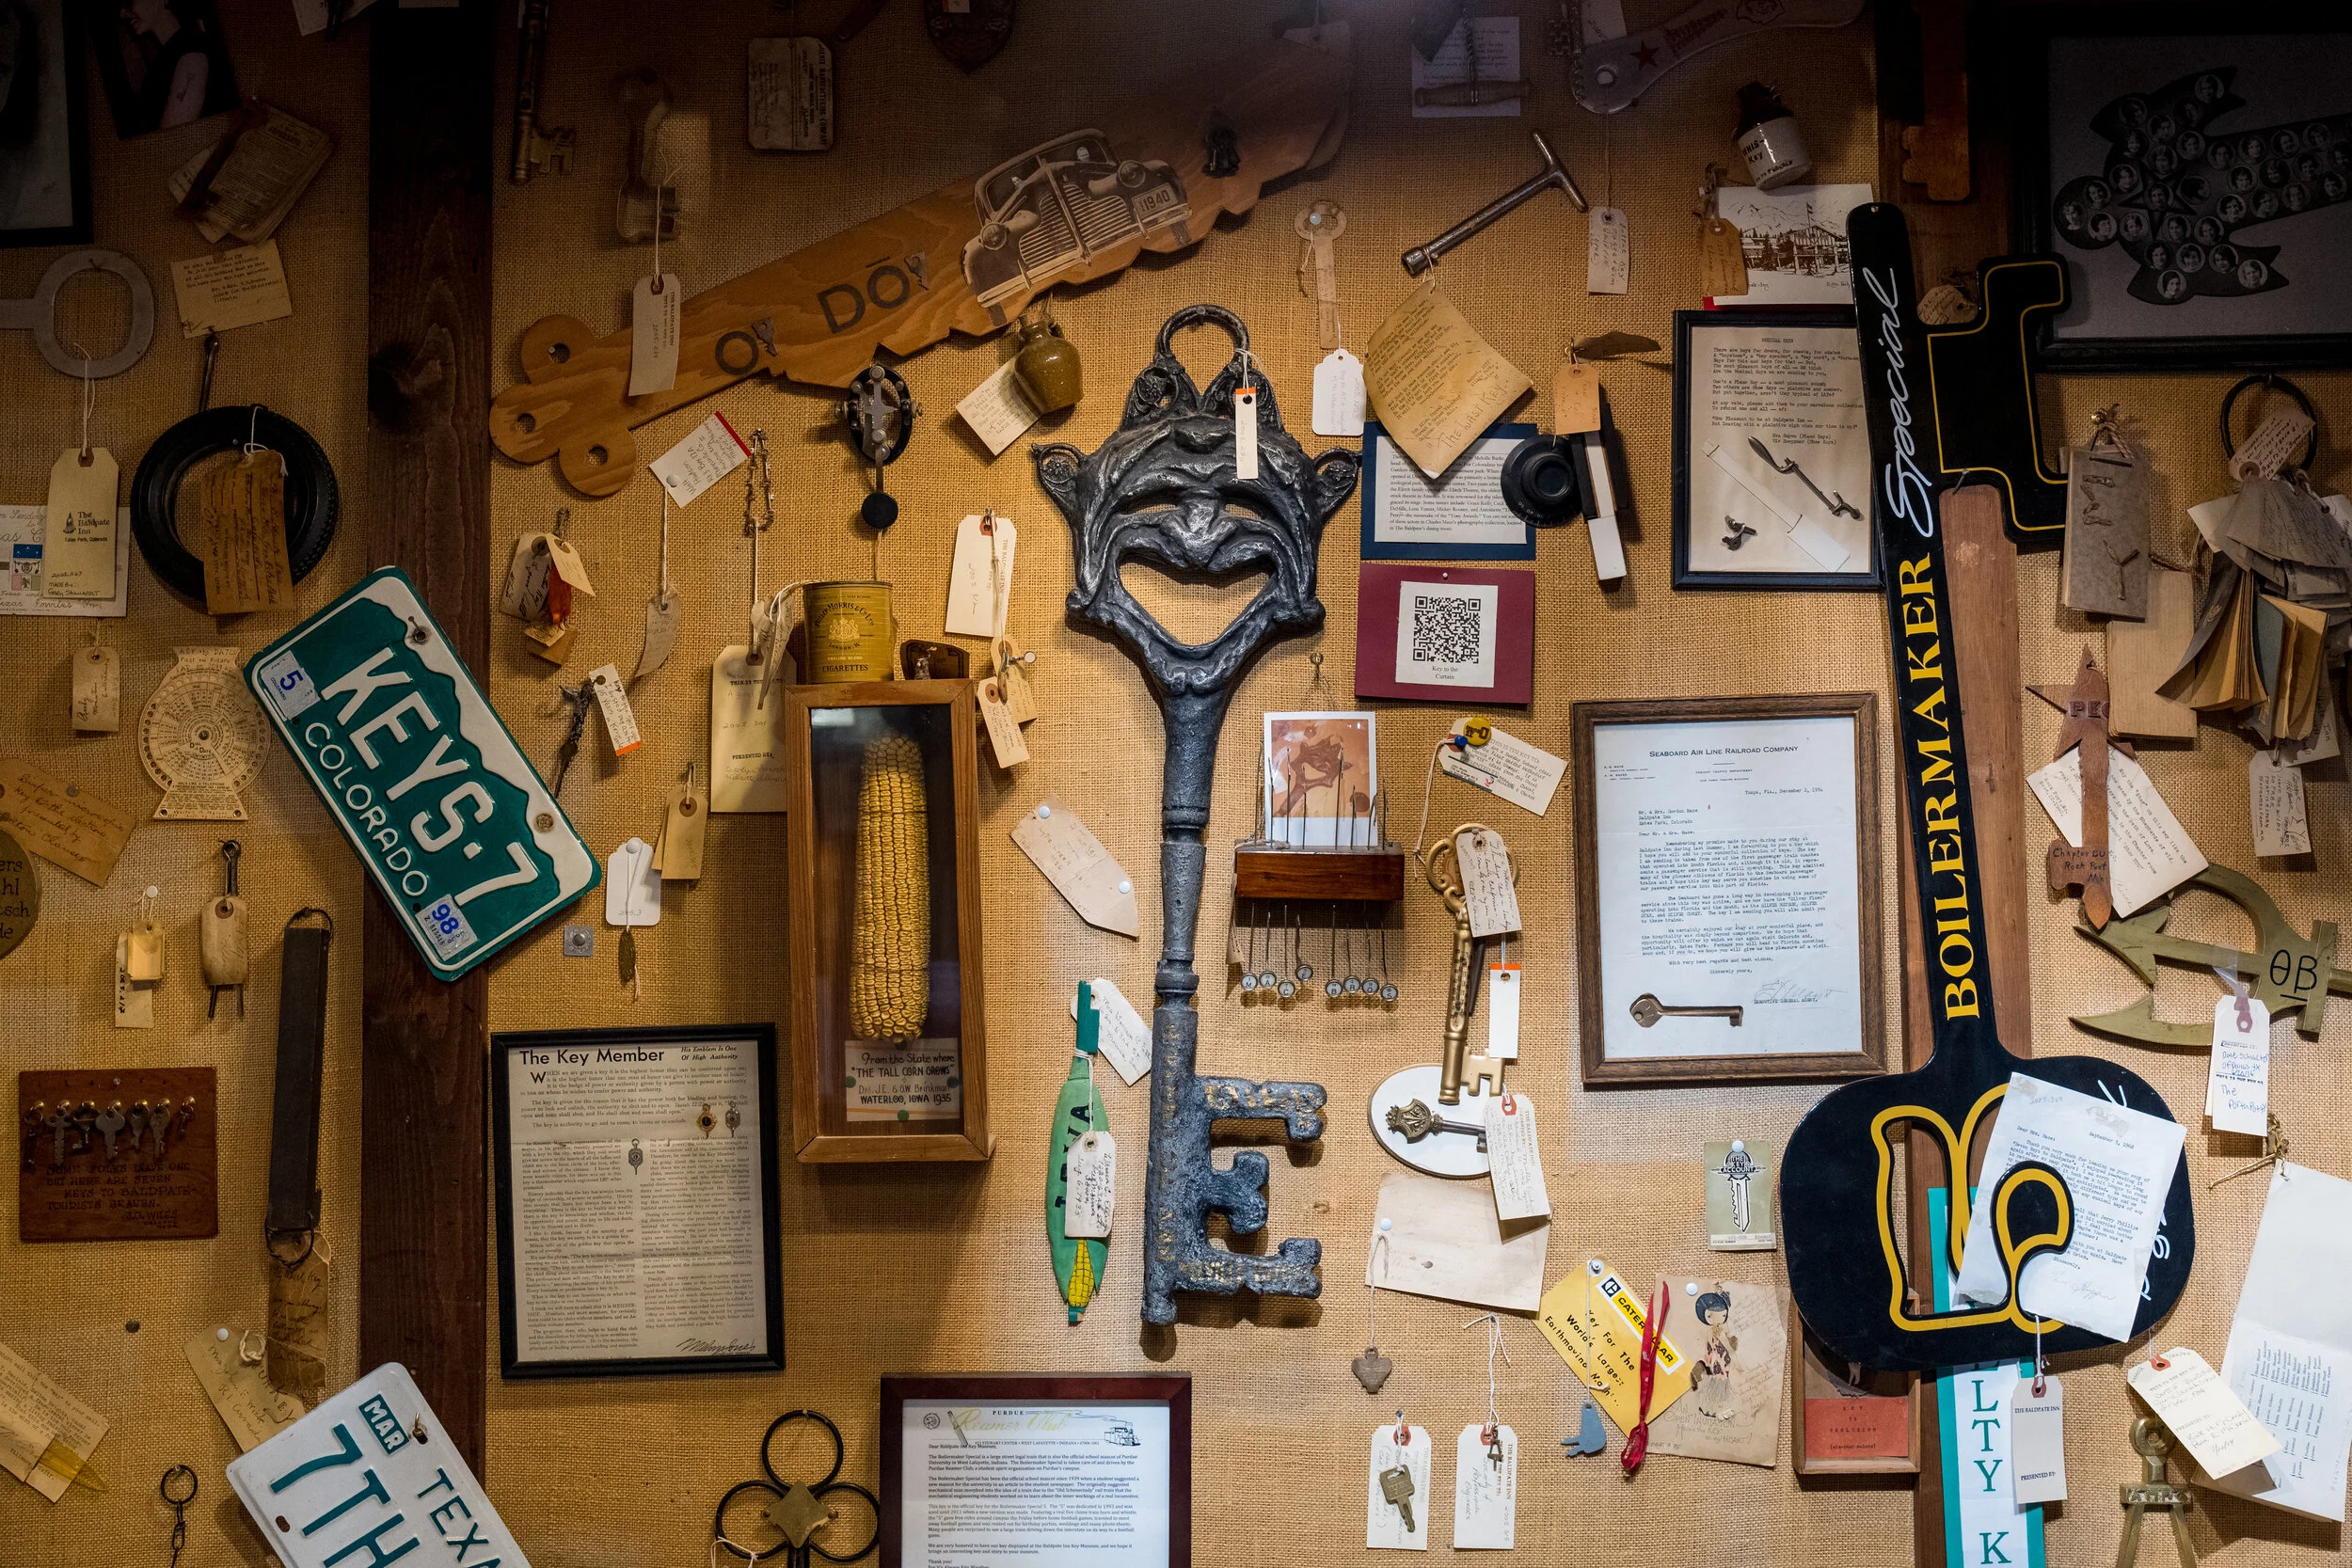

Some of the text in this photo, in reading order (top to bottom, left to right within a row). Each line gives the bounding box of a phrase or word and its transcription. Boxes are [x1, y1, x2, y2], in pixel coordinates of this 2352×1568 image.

[1863, 267, 1932, 539] Special
[827, 602, 854, 612] MORRIS
[280, 671, 304, 691] 5
[1899, 552, 1979, 1021] BOILERMAKER
[305, 721, 429, 897] COLORADO
[432, 903, 459, 936] 98
[519, 1047, 664, 1066] The Key Member
[862, 1052, 955, 1065] From the State where
[879, 1067, 899, 1077] TALL
[902, 1067, 923, 1076] CORN
[861, 1094, 952, 1105] WATERLOO, IOWA 1935
[2089, 1131, 2113, 1142] September
[168, 1162, 190, 1171] ONE
[107, 1176, 127, 1185] ARE
[134, 1174, 171, 1184] SEVEN
[64, 1188, 94, 1198] KEYS
[100, 1188, 114, 1197] TO
[47, 1201, 101, 1210] TOURISTS
[1603, 1332, 1616, 1347] For
[1619, 1351, 1635, 1371] The
[364, 1400, 405, 1451] MAR
[1972, 1367, 2003, 1492] LTY
